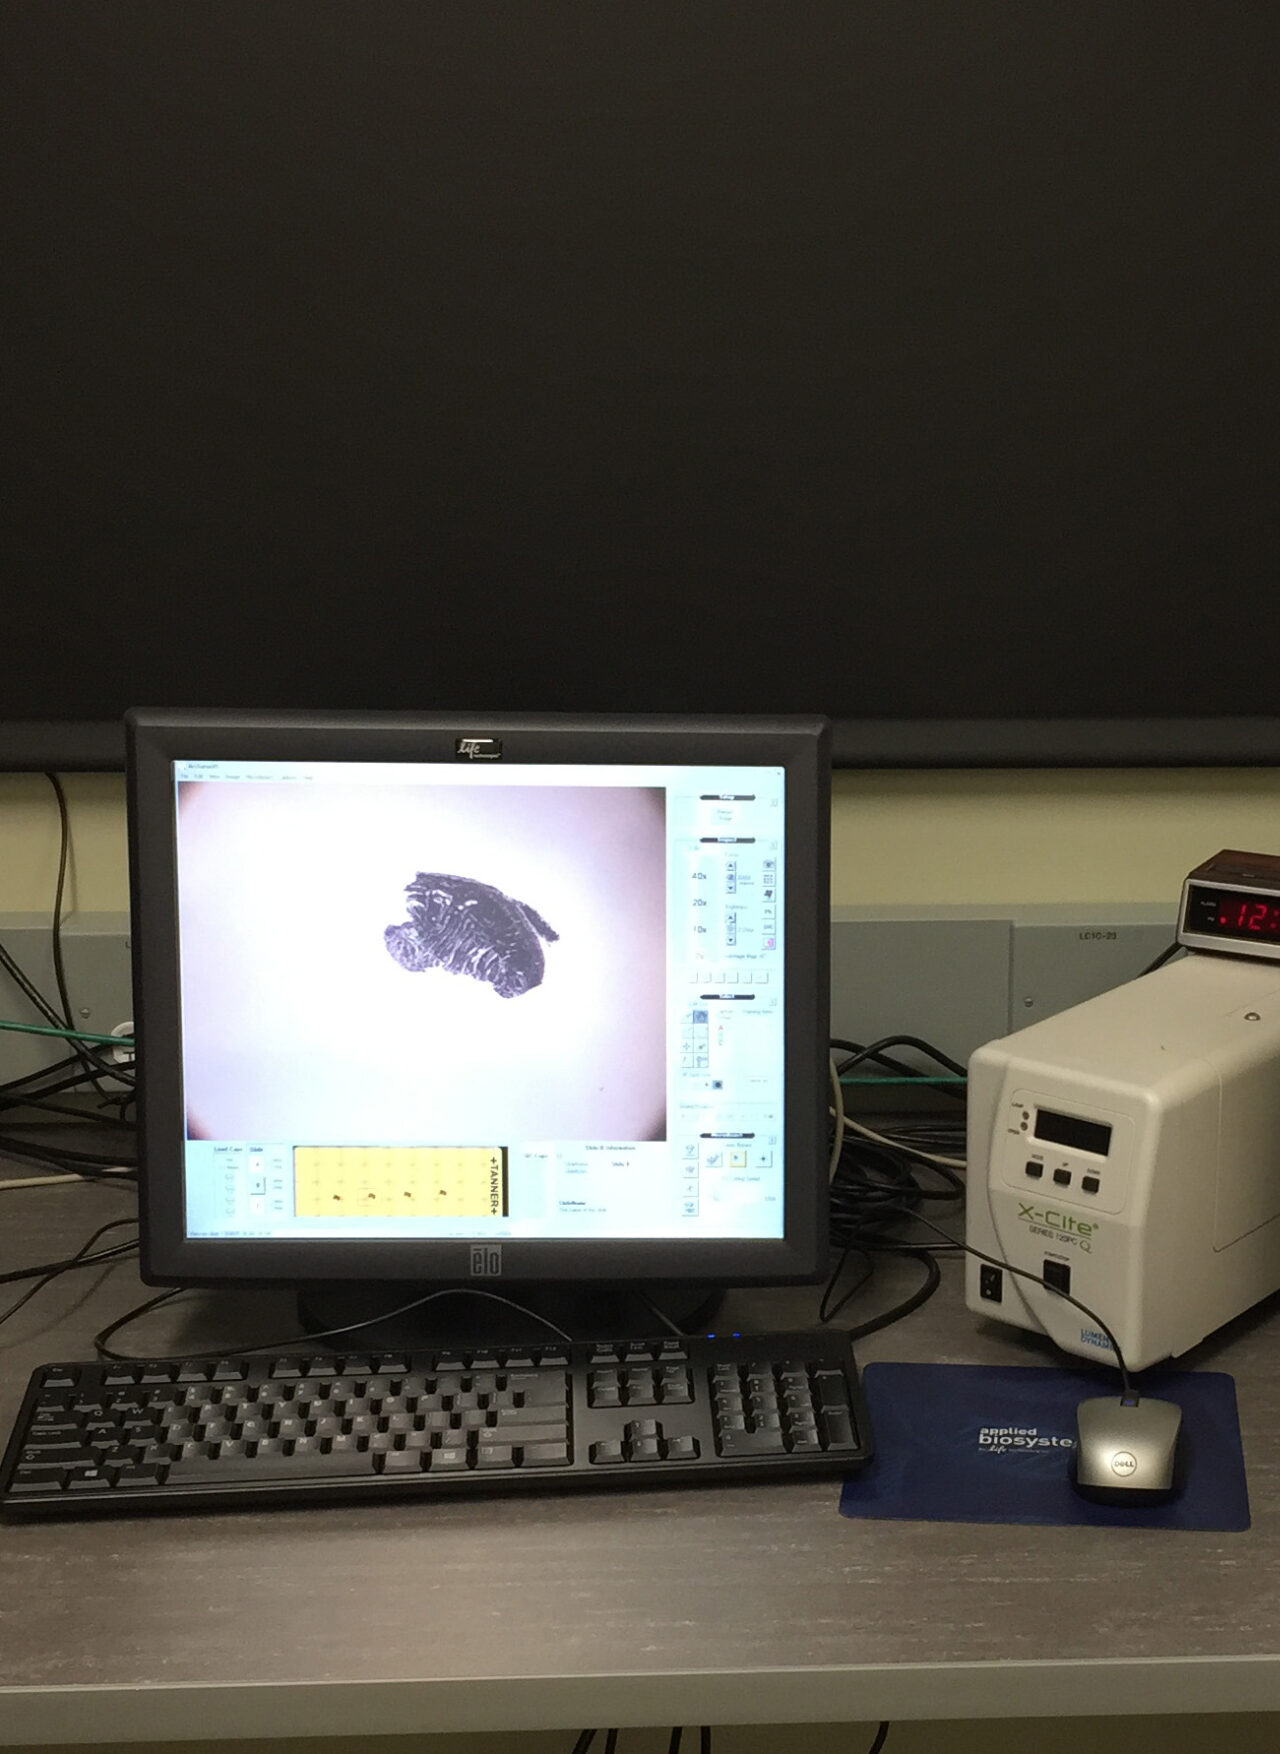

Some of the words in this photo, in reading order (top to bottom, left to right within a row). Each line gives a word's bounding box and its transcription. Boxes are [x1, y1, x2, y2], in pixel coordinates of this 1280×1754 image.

[692, 872, 707, 880] 40x
[1028, 1224, 1054, 1240] SERIES
[1080, 1239, 1092, 1254] Q
[980, 1427, 1037, 1436] applied
[978, 1434, 1077, 1449] biosyste
[1114, 1460, 1134, 1468] DELL
